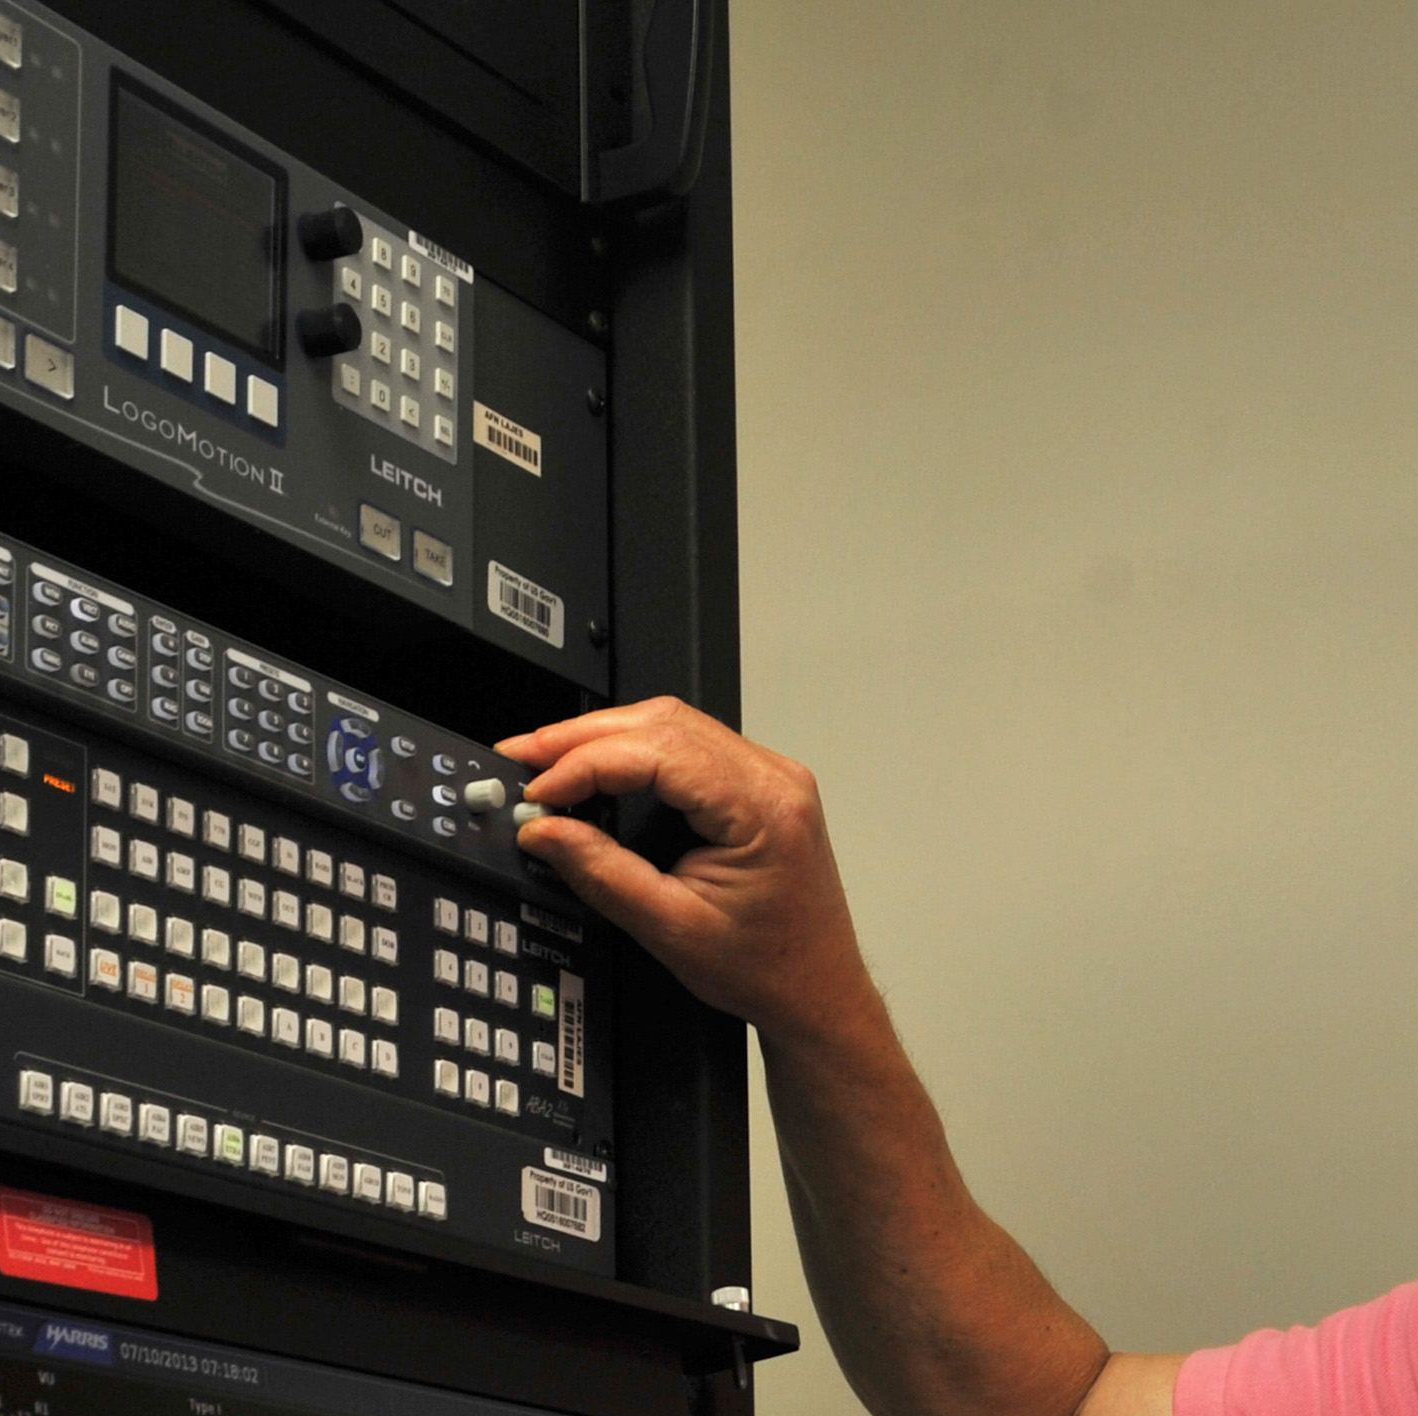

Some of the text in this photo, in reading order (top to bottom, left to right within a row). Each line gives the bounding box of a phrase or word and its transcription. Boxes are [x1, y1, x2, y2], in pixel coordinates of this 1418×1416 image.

[380, 246, 387, 260] 8
[350, 279, 356, 291] 4
[380, 294, 387, 309] 5
[409, 310, 416, 325] 6
[379, 341, 386, 355] 2
[409, 358, 416, 372] 3
[379, 389, 386, 403] 0
[371, 453, 443, 508] LEITCH
[424, 548, 447, 569] TAKE
[495, 565, 523, 588] Property
[522, 580, 531, 592] of
[530, 584, 540, 597] US
[521, 939, 571, 968] LEITCH
[100, 961, 116, 977] LIVE
[529, 1170, 557, 1189] Property
[566, 1181, 574, 1193] US
[514, 1229, 561, 1253] LEITCH
[46, 1324, 110, 1350] HARRIS
[120, 1342, 259, 1385] 07/10/2013 07:18:02
[38, 1370, 56, 1387] VU
[189, 1398, 215, 1416] Type
